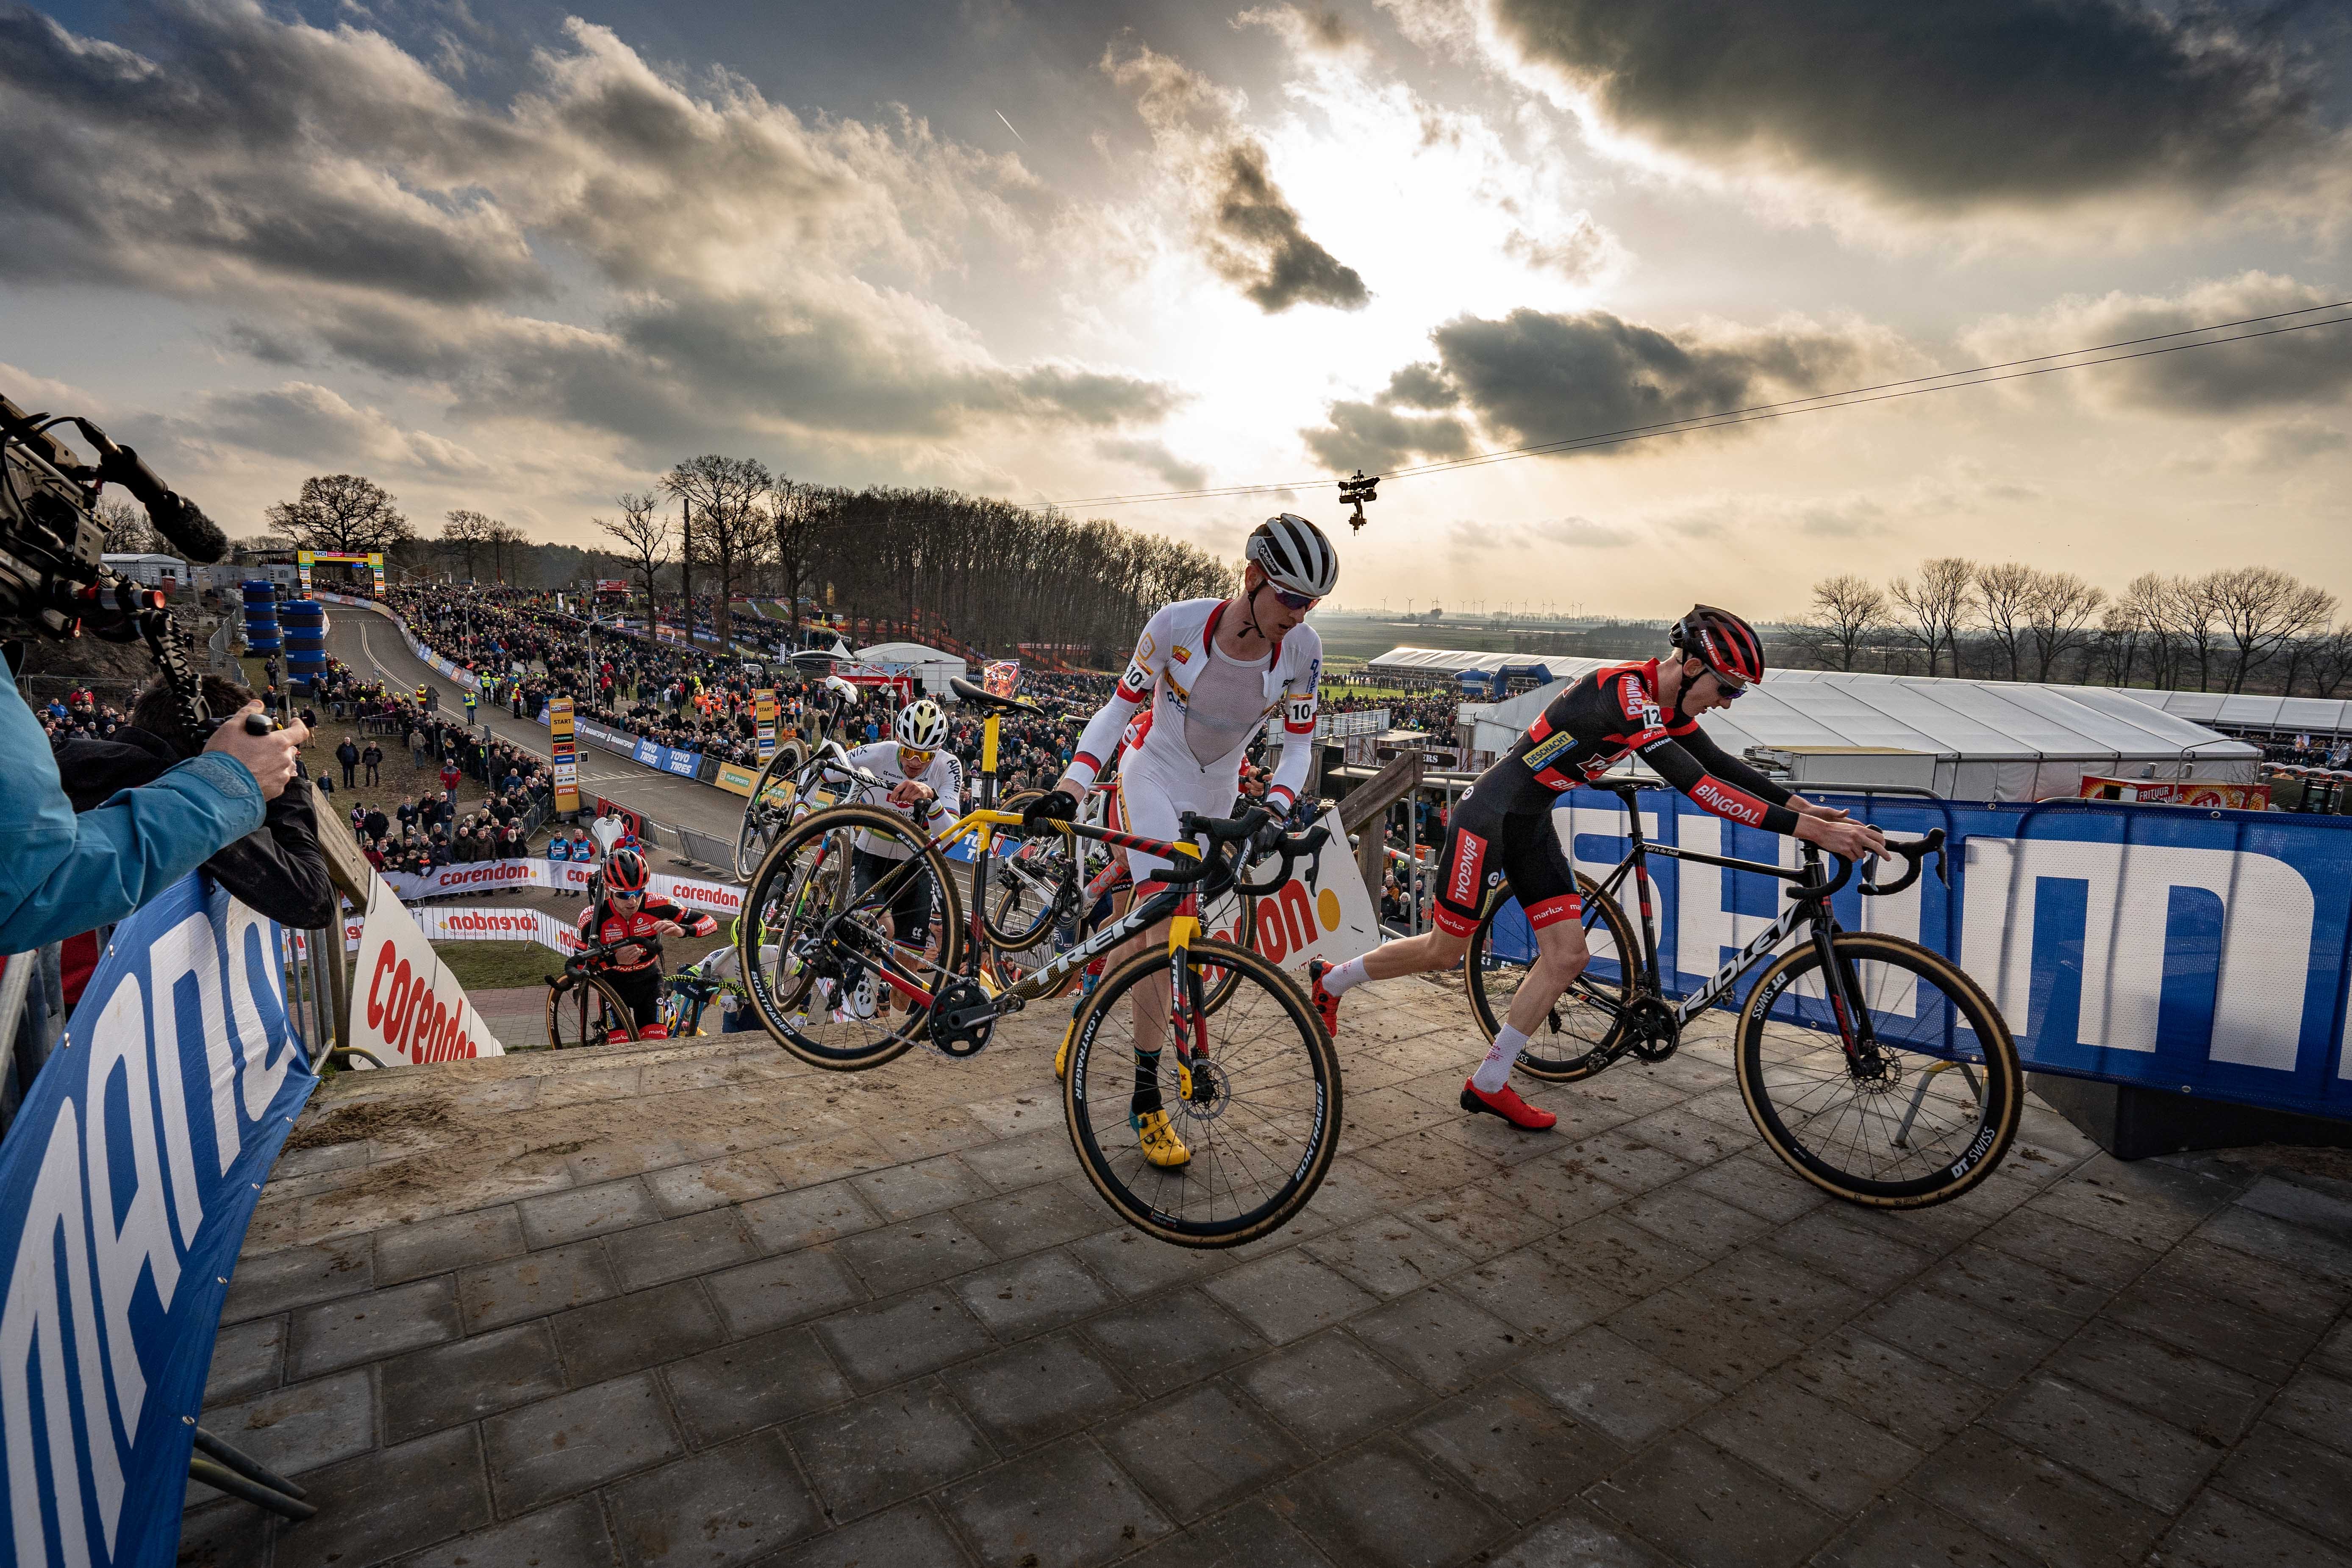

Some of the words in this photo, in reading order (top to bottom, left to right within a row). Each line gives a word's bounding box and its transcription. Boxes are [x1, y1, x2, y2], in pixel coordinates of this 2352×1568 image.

[1263, 553, 1277, 572] Baloise
[1700, 630, 1713, 650] Pauwels
[1126, 666, 1143, 686] 10
[1728, 669, 1755, 682] LAZER
[1293, 704, 1310, 719] 10
[1643, 709, 1663, 725] 12
[585, 727, 607, 740] BRABANTSPORT
[606, 733, 611, 741] B
[611, 736, 635, 749] BRABANTSPORT
[641, 741, 657, 753] TOYO
[1526, 734, 1570, 765] DESCHACHT
[1562, 741, 1575, 752] partner
[1644, 738, 1673, 753] isolteam
[640, 752, 657, 764] TIRES
[670, 750, 690, 763] TOYO
[1547, 752, 1560, 761] project
[671, 761, 692, 775] TIRES
[947, 759, 960, 793] Alpecin
[735, 776, 749, 786] SPORTS
[2139, 787, 2169, 802] FRITUUR
[897, 833, 943, 899] BONTRGER
[440, 863, 528, 886] corendon
[673, 885, 739, 907] corendon
[1533, 906, 1563, 921] marlux
[1439, 914, 1465, 931] marlux
[1027, 908, 1147, 988] TREK
[1679, 904, 1797, 1022] RIDLEY
[1172, 955, 1180, 1012] TREK
[1772, 971, 1788, 991] DT
[686, 985, 700, 995] Santic
[550, 1001, 555, 1010] DT
[751, 971, 794, 1036] BONTRAGER
[1596, 1001, 1616, 1015] SwissStop
[1752, 987, 1773, 1020] SWISS
[1075, 1010, 1100, 1100] ONTRAGER
[1296, 1082, 1323, 1182] BONTRAGER
[1951, 1158, 1969, 1179] DT
[1969, 1126, 1995, 1163] SWISS
